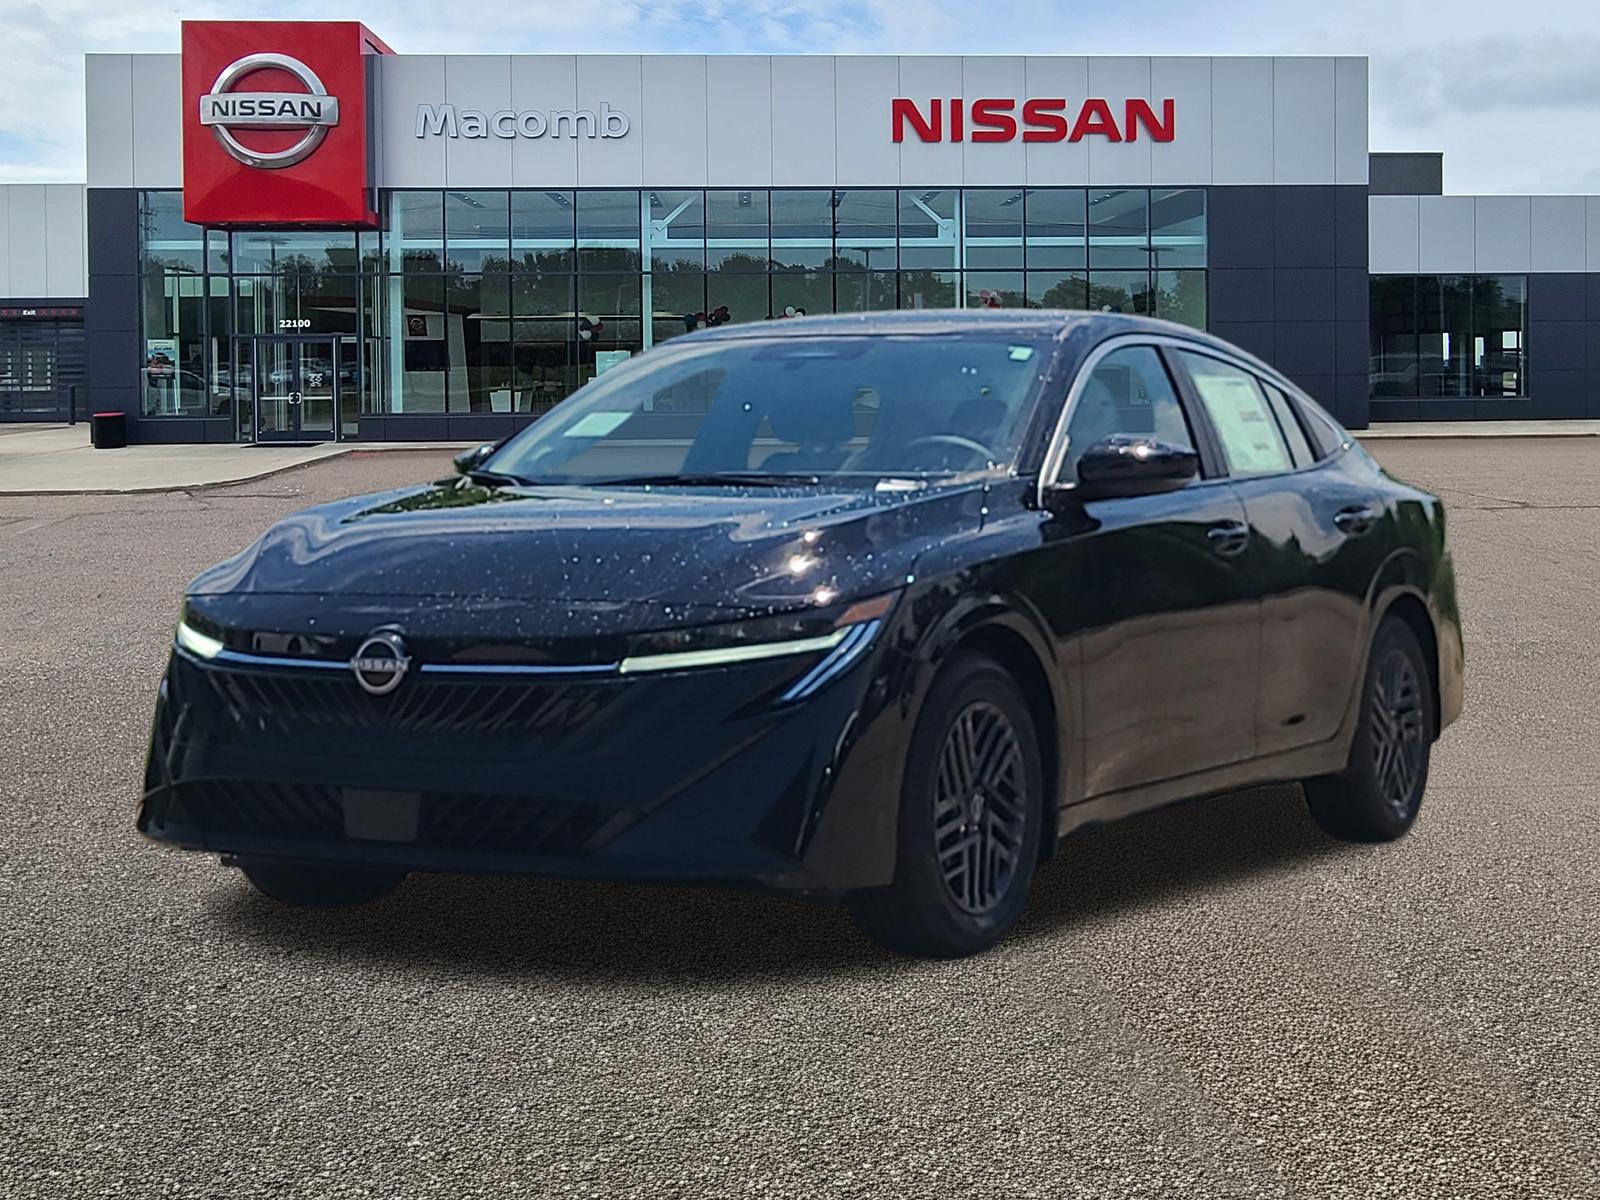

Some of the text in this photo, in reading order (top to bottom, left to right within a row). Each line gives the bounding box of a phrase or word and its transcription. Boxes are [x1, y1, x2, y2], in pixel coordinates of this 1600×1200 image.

[211, 99, 322, 118] NISSAN
[415, 101, 630, 140] Macomb
[892, 98, 1175, 143] NISSAN
[279, 319, 311, 328] 22100
